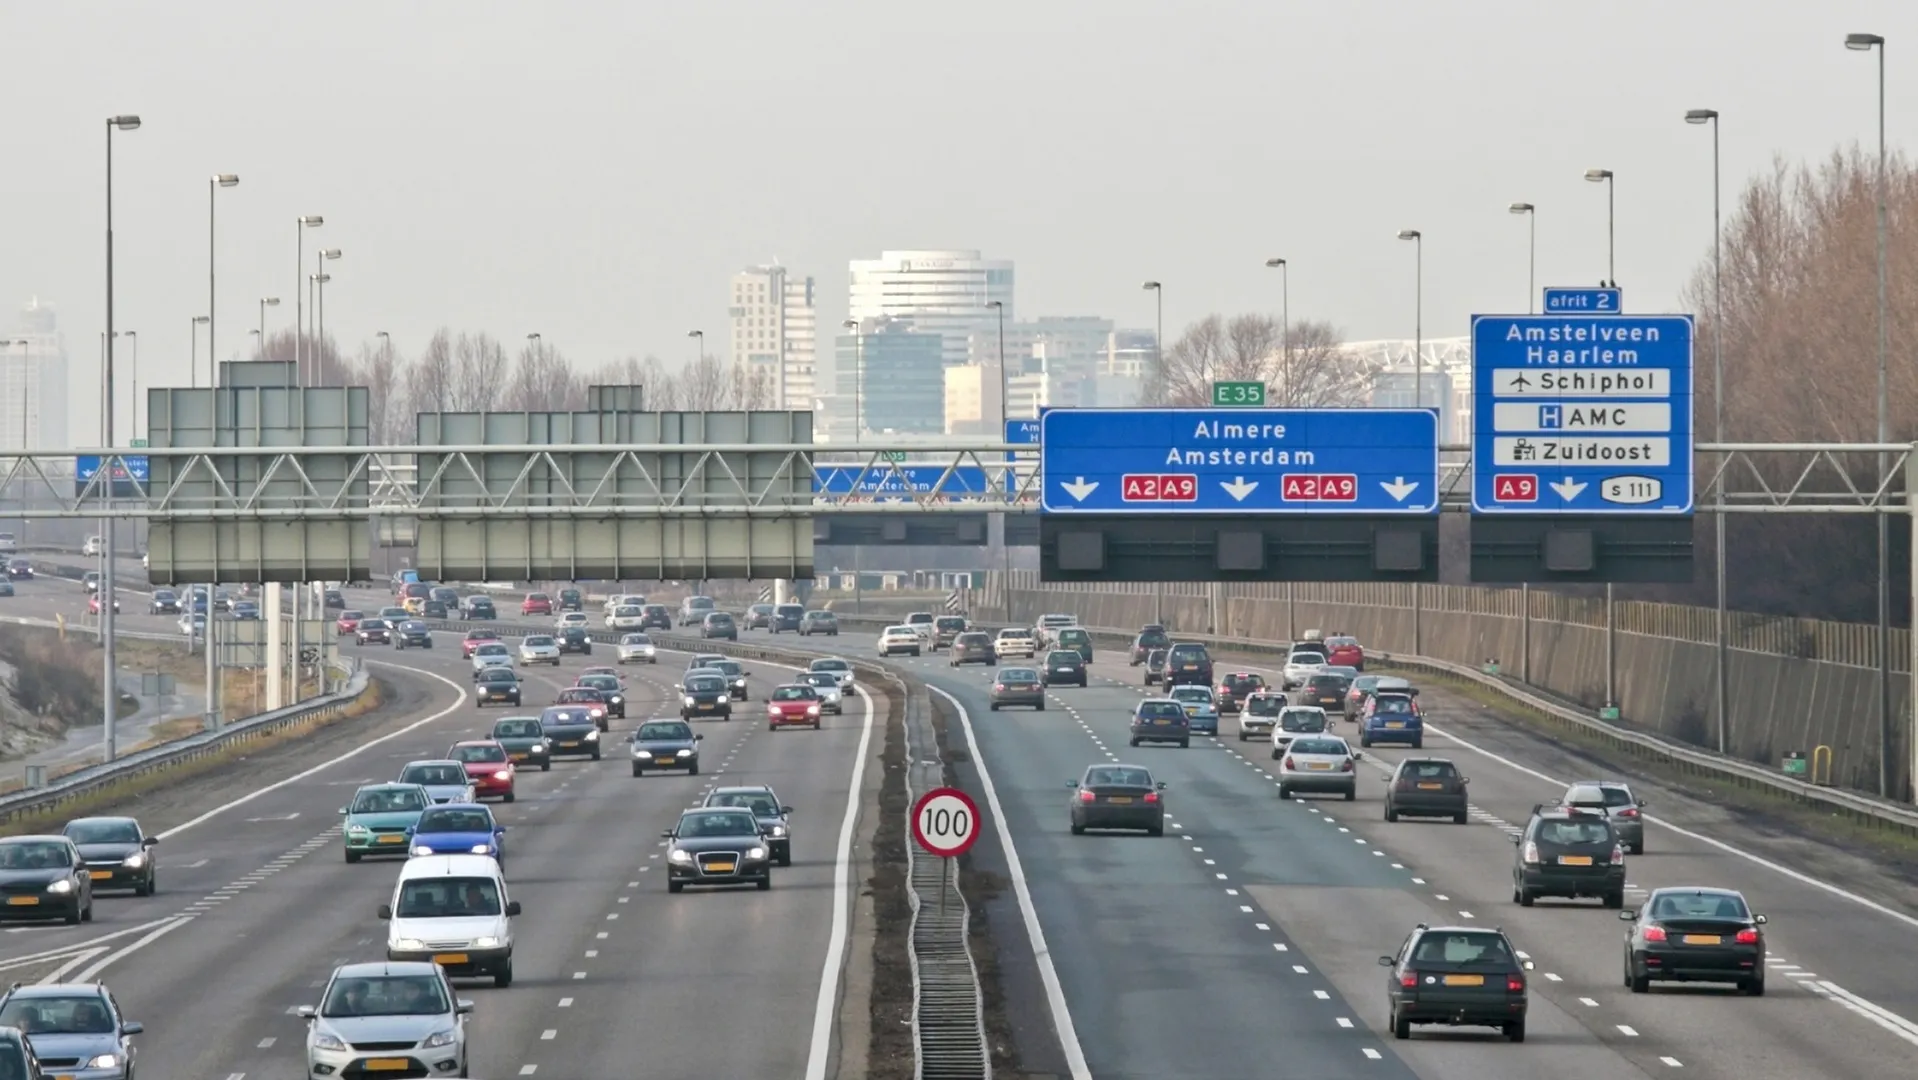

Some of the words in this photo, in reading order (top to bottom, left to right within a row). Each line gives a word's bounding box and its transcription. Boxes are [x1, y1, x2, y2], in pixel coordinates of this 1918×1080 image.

[1550, 294, 1588, 307] afrit
[1596, 293, 1610, 308] 2
[1506, 323, 1660, 341] Amstelveen
[1527, 346, 1638, 364] Haarlem
[1541, 373, 1653, 393] Schiphol
[1569, 408, 1626, 426] AMC
[1194, 421, 1286, 438] Almere
[1166, 447, 1314, 465] Amsterdam
[1543, 443, 1651, 460] Zuidoost
[1126, 480, 1156, 496] A2
[1163, 480, 1193, 496] A9
[1286, 480, 1316, 496] A2
[1323, 480, 1353, 496] A9
[1629, 483, 1653, 496] 111
[925, 808, 968, 838] 100
